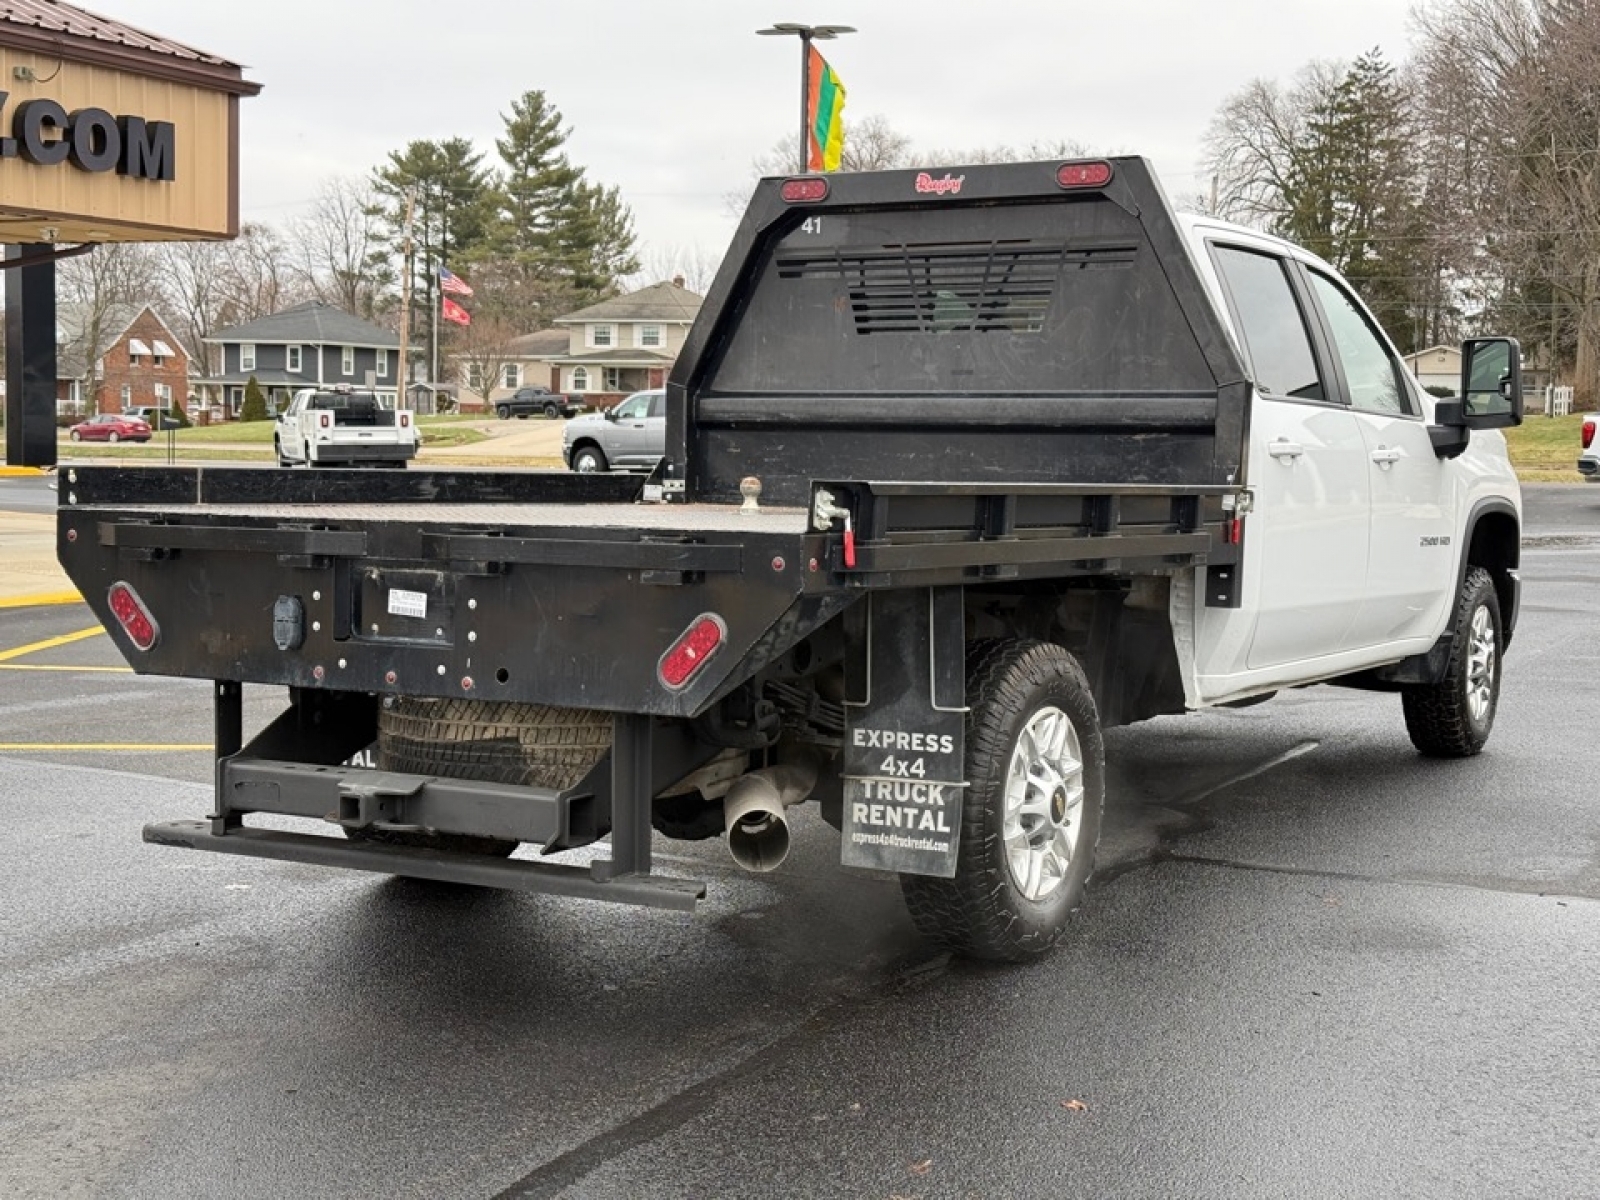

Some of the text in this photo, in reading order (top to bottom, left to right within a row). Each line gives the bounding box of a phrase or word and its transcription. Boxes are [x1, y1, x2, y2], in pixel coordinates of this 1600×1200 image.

[0, 91, 176, 182] .COM
[801, 216, 822, 234] 41
[853, 728, 954, 753] EXPRESS
[342, 749, 376, 768] AL
[880, 755, 926, 778] 4x4
[860, 779, 945, 806] TRUCK
[852, 802, 951, 833] RENTAL
